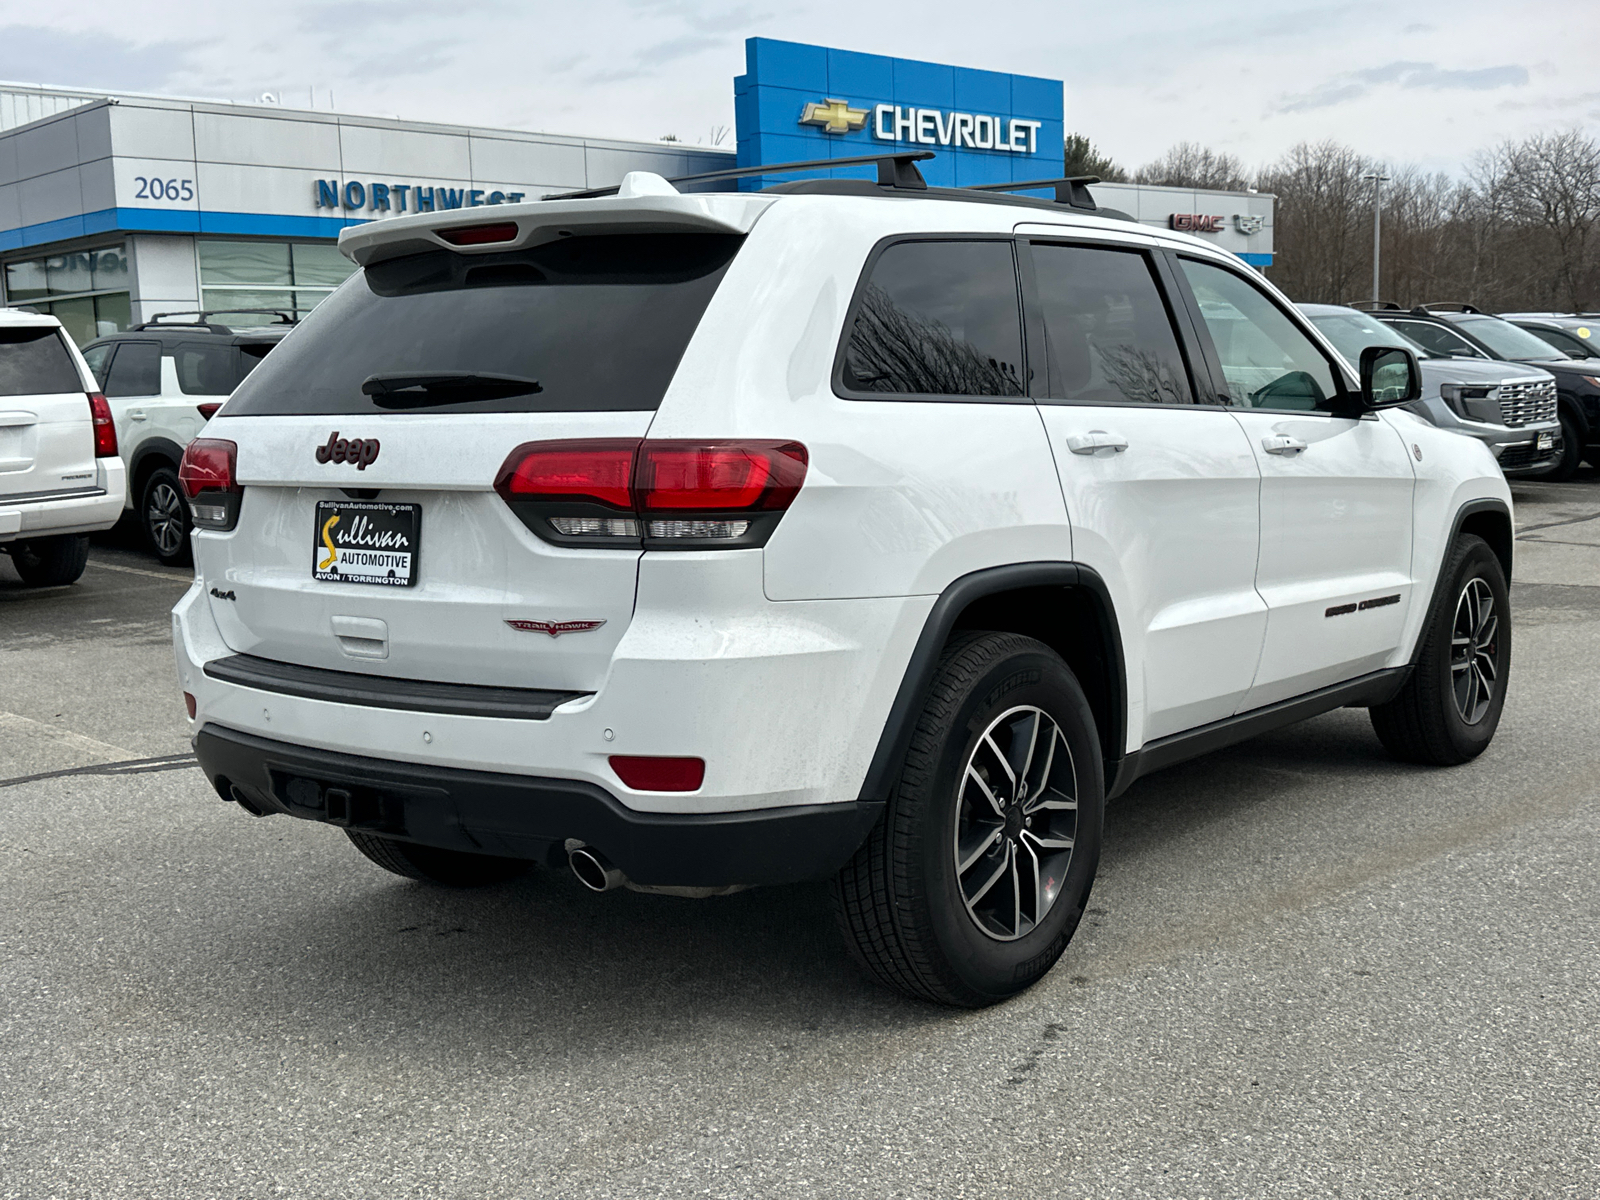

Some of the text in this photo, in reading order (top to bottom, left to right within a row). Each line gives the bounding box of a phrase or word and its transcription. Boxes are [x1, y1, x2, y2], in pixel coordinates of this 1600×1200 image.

[875, 103, 1042, 153] CHEVROLET
[134, 176, 194, 201] 2065
[1170, 213, 1225, 232] GMC
[316, 431, 380, 471] Jeep
[319, 501, 413, 511] SullivanAutomotive.com
[318, 514, 409, 570] Sullivan
[340, 552, 408, 569] AUTOMOTIVE
[315, 573, 340, 581] AVON
[348, 575, 408, 585] TORRINGTON
